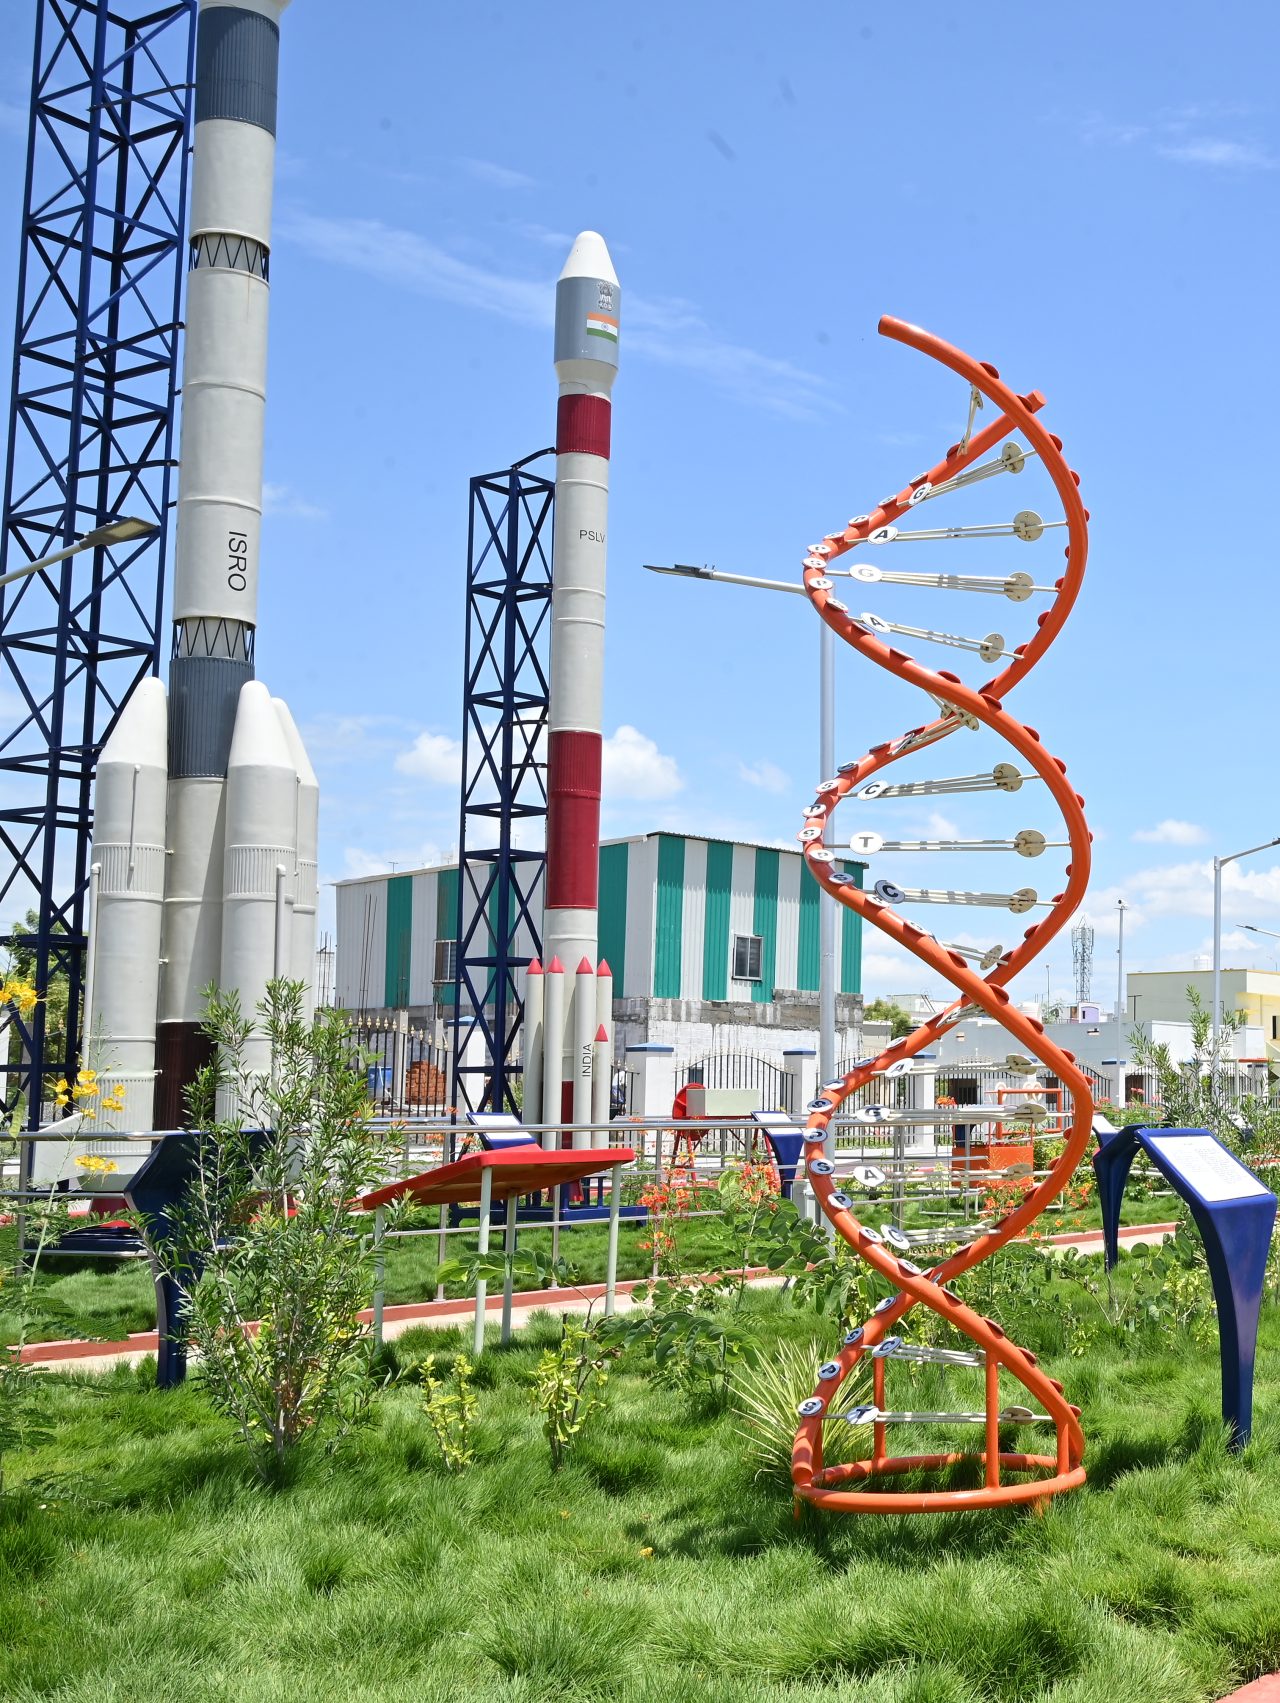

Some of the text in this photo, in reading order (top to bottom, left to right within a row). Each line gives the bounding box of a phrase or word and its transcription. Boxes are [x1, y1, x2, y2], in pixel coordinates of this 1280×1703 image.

[580, 530, 605, 543] PSLV
[873, 529, 888, 539] A
[228, 531, 247, 591] ISRO
[858, 568, 874, 577] G
[869, 616, 885, 628] A
[865, 784, 880, 794] C
[858, 836, 874, 848] T
[882, 884, 899, 898] C
[582, 1043, 592, 1077] INDIA
[890, 1064, 905, 1074] A
[816, 1162, 831, 1172] S
[864, 1169, 880, 1180] A
[880, 1340, 895, 1352] C
[821, 1364, 836, 1374] P
[802, 1401, 817, 1412] S
